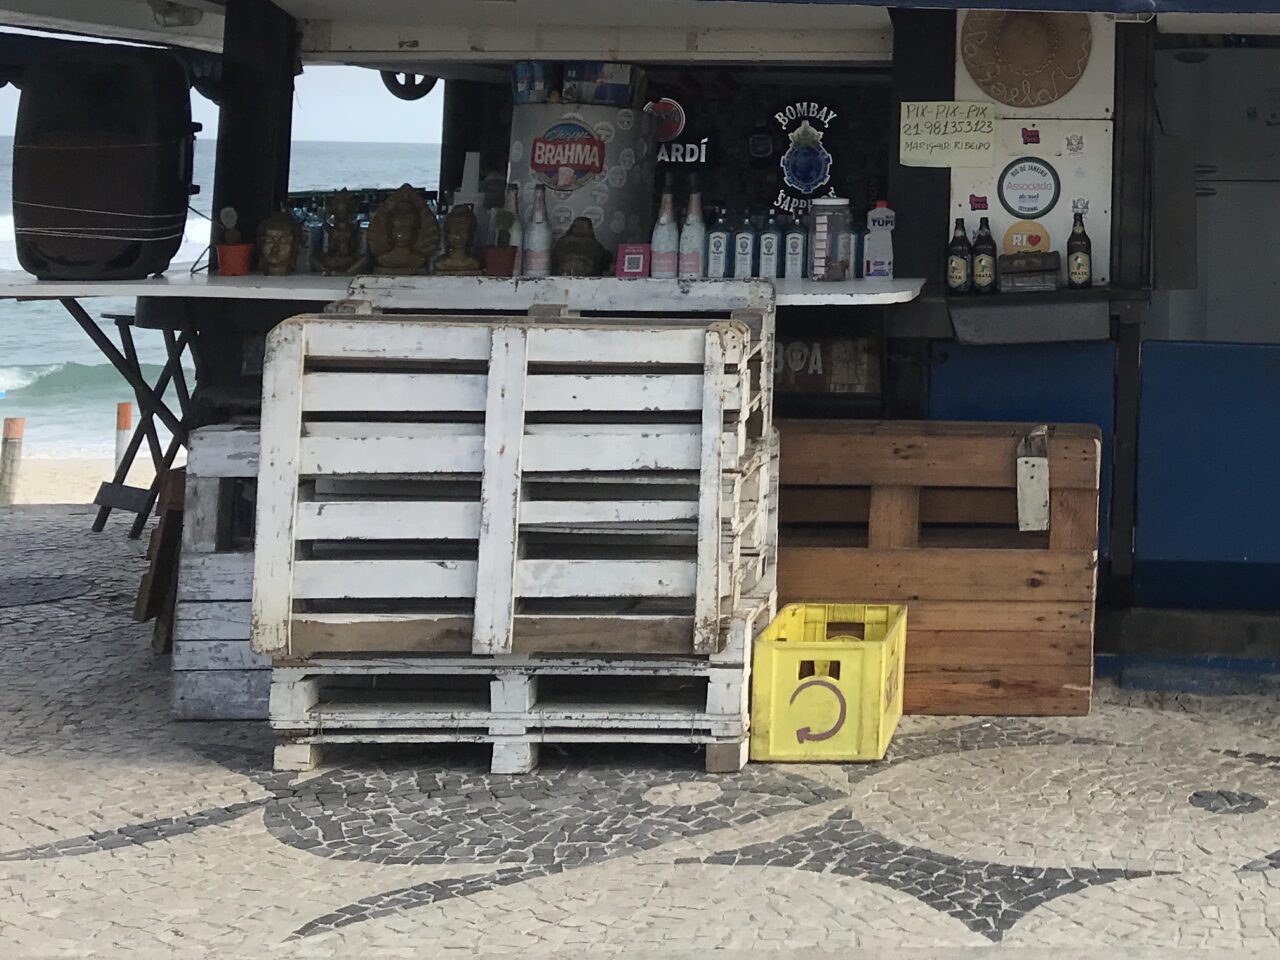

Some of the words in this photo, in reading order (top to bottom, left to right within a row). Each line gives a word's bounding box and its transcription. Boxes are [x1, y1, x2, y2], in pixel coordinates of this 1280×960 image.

[773, 101, 838, 131] BOMBAY
[534, 141, 601, 168] BRAHMA
[656, 137, 709, 163] ARDÍ
[1006, 181, 1052, 191] Associado
